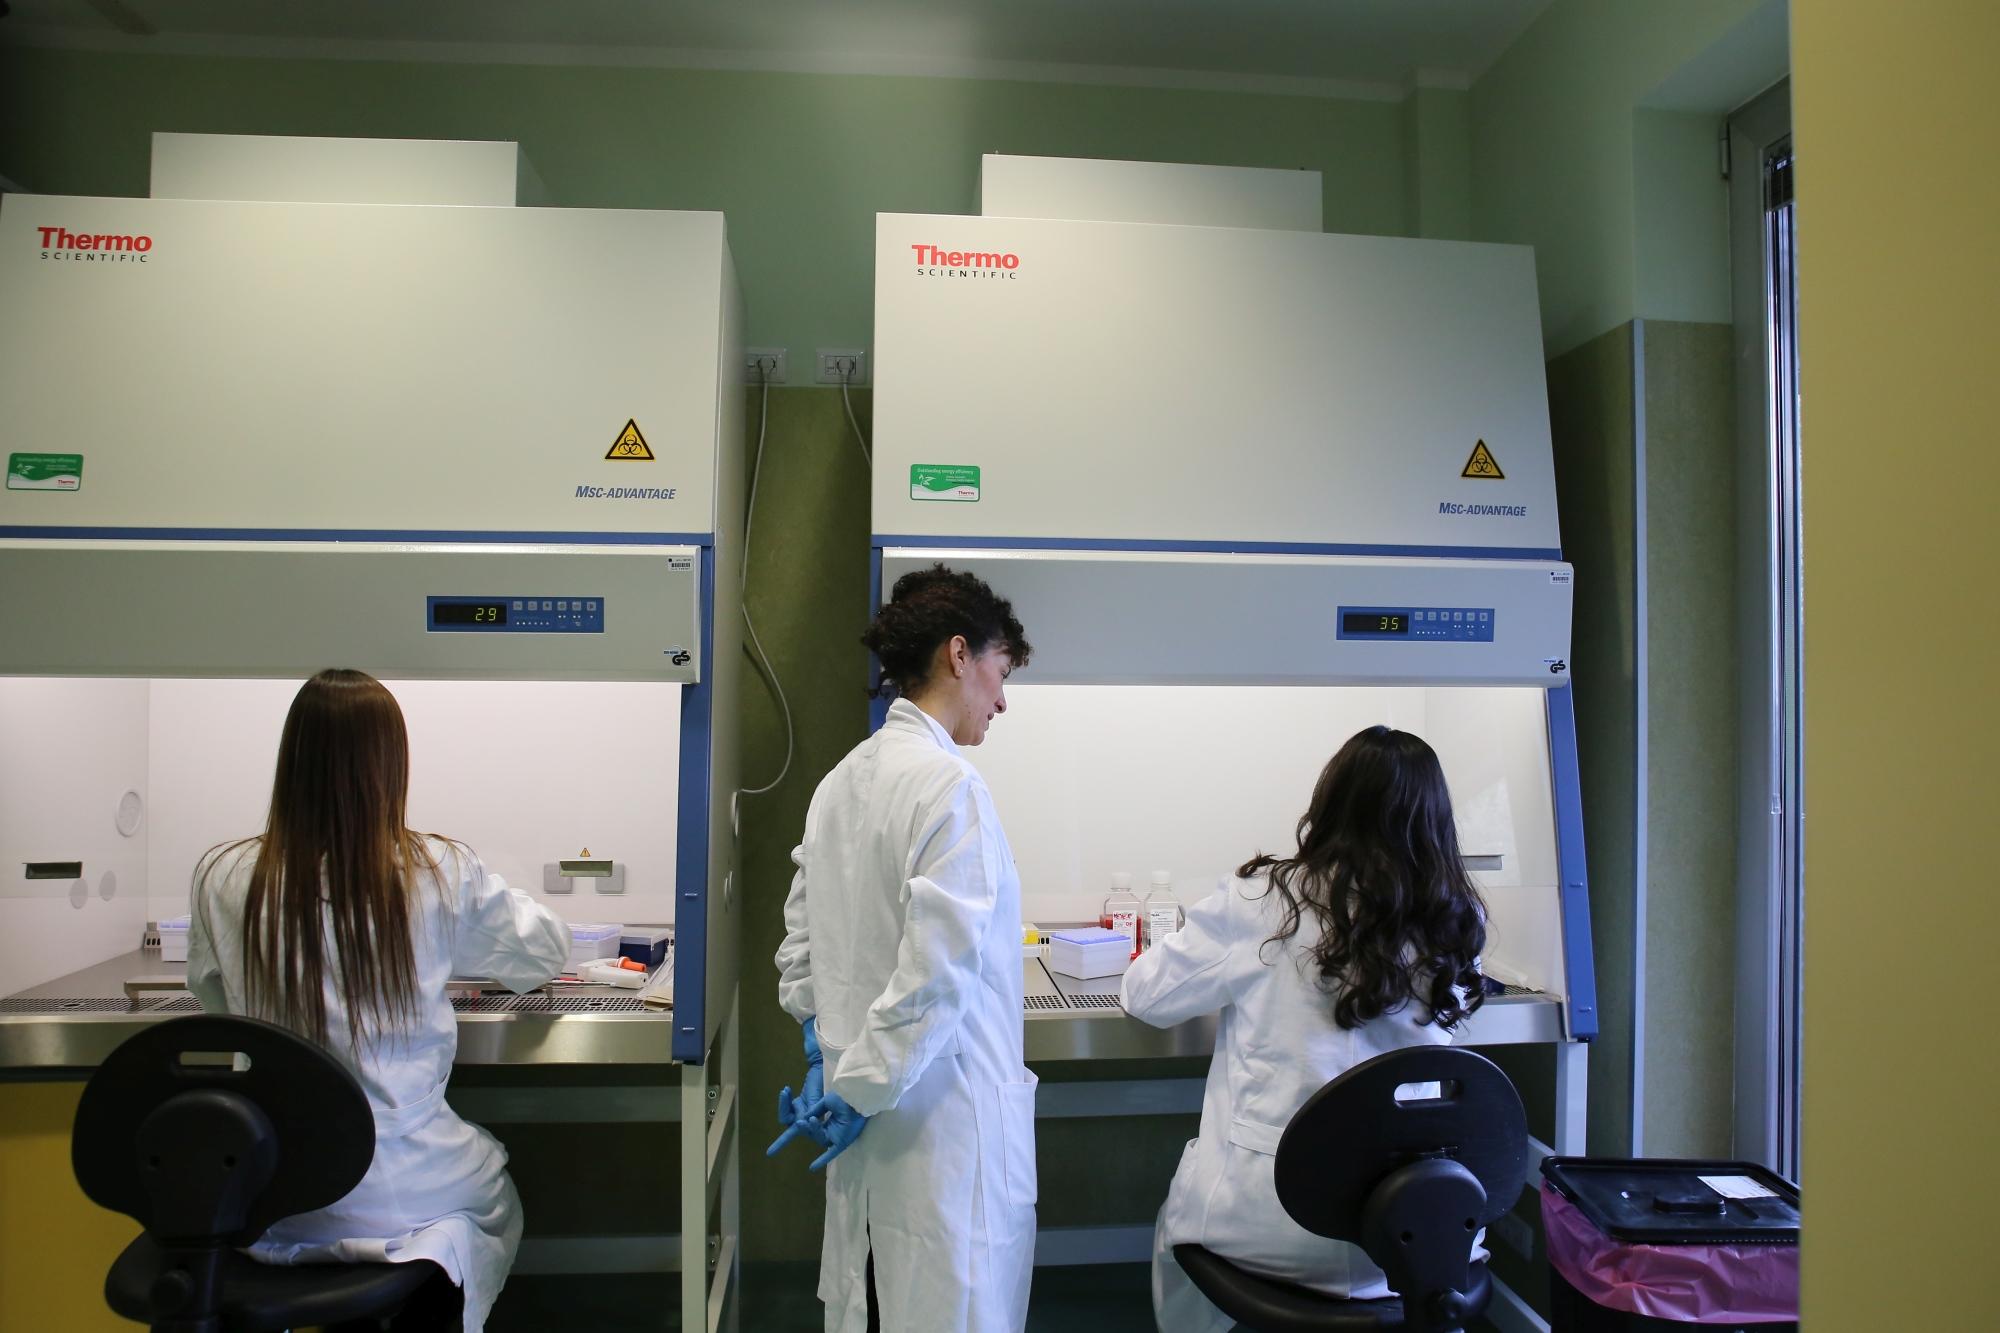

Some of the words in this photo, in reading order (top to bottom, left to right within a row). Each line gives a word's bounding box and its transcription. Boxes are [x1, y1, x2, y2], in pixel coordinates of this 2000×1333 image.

[37, 226, 152, 252] Thermo
[41, 251, 148, 263] SCIENTIFIC
[911, 244, 1020, 269] Thermo
[917, 268, 1017, 280] SCIENTIFIC
[475, 607, 497, 621] 29
[1379, 617, 1399, 630] 35
